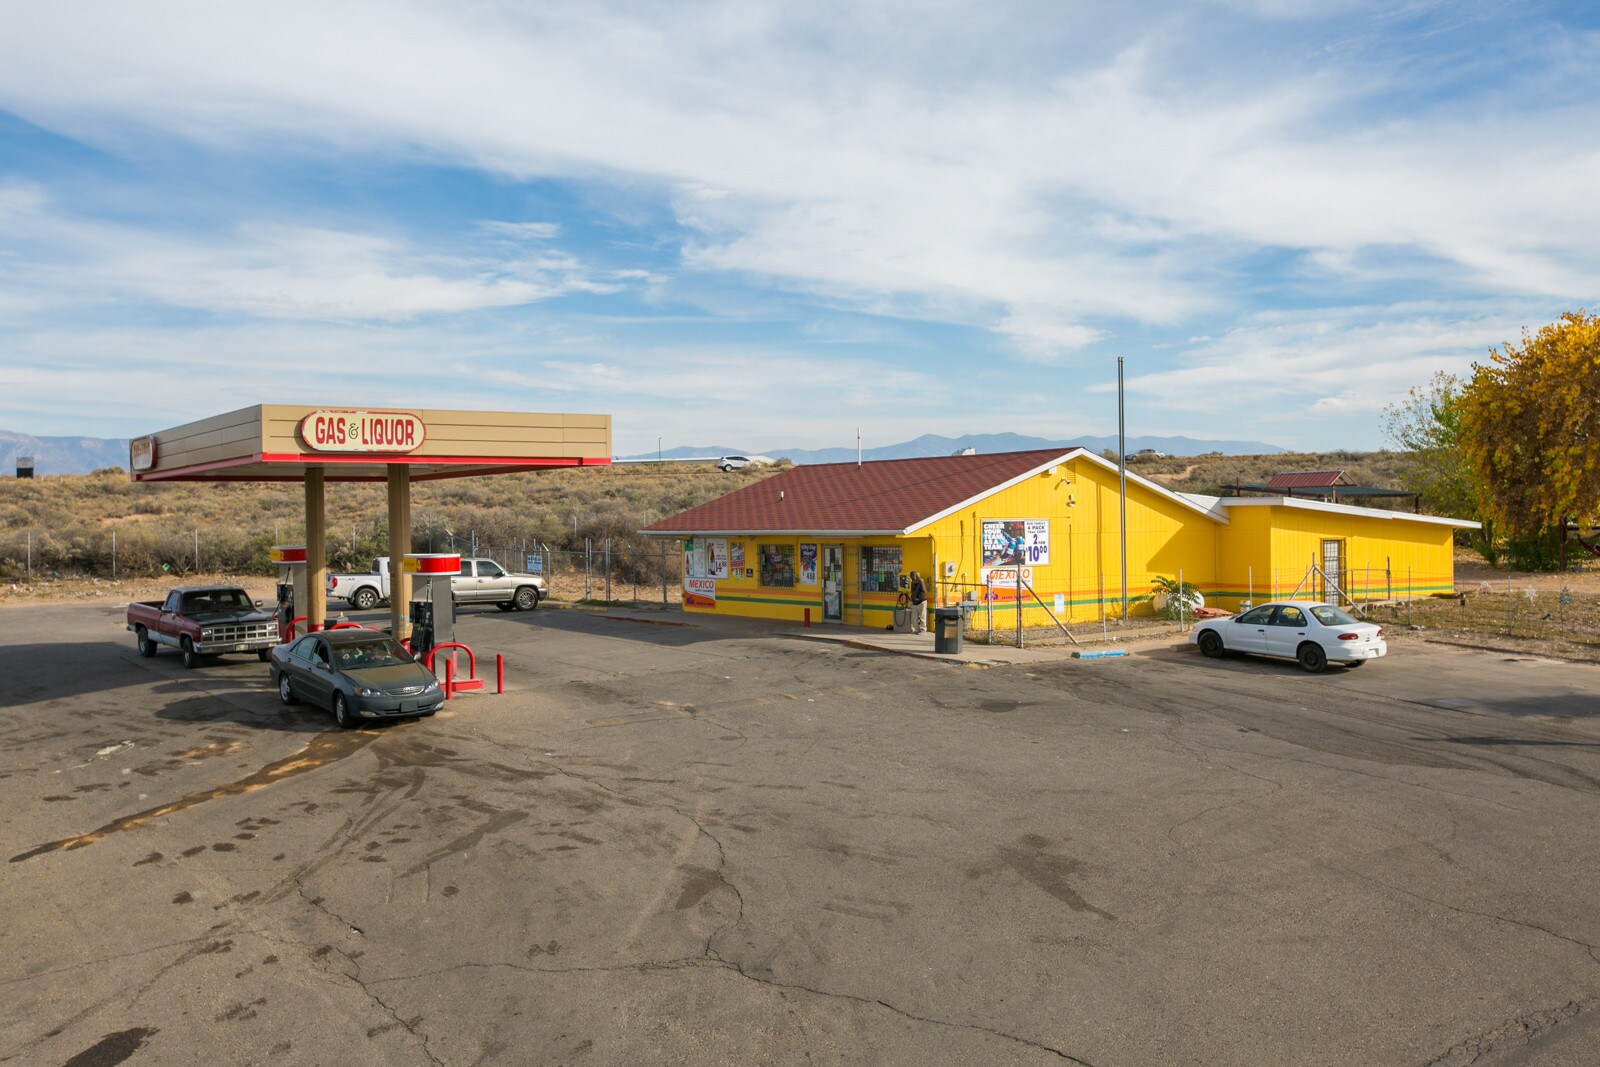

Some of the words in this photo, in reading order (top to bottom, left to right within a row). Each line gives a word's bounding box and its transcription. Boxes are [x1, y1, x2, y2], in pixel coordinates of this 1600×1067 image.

[315, 416, 346, 445] GAS
[348, 423, 359, 440] &
[361, 418, 415, 446] LIQUOR
[1033, 534, 1038, 545] 2
[416, 559, 422, 571] 4
[989, 569, 1030, 580] MEXIO
[688, 579, 714, 589] MEXICO
